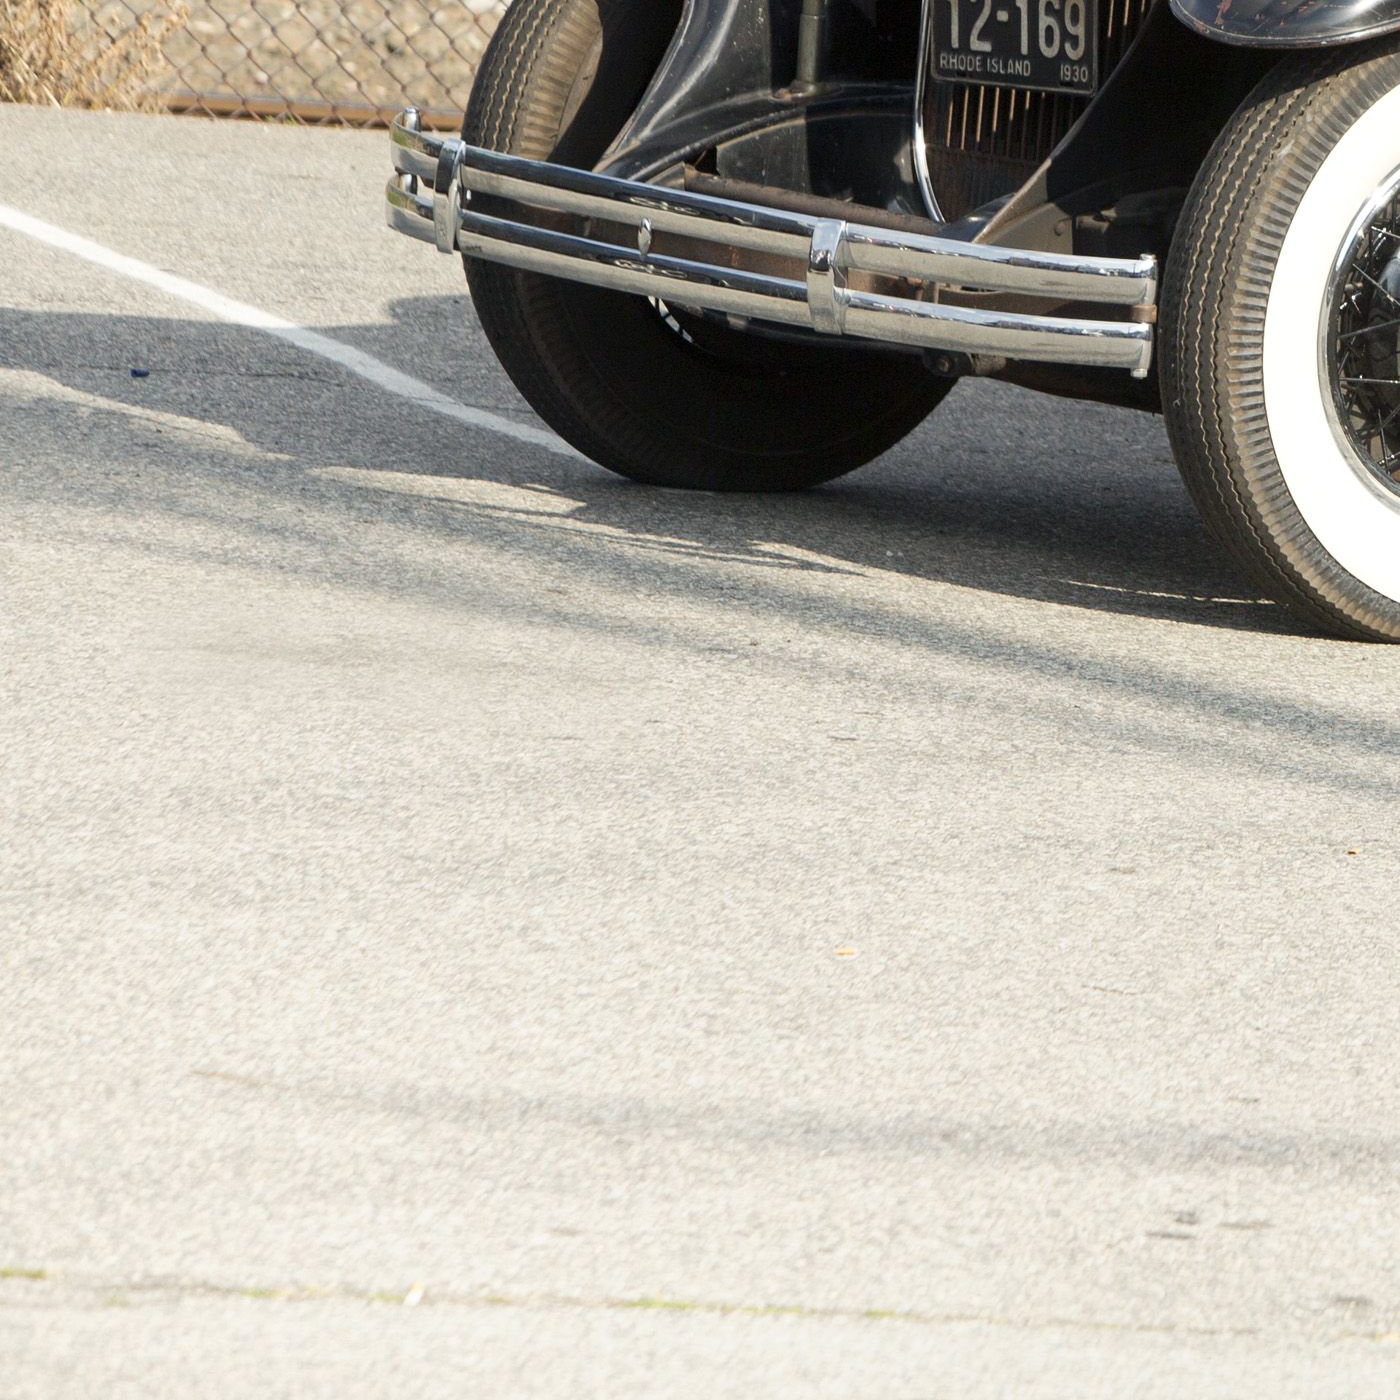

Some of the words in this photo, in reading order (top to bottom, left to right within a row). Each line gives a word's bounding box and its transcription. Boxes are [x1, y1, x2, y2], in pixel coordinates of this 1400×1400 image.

[940, 52, 982, 72] RHODE
[987, 57, 1031, 77] ISLAND
[1060, 63, 1089, 83] 1930
